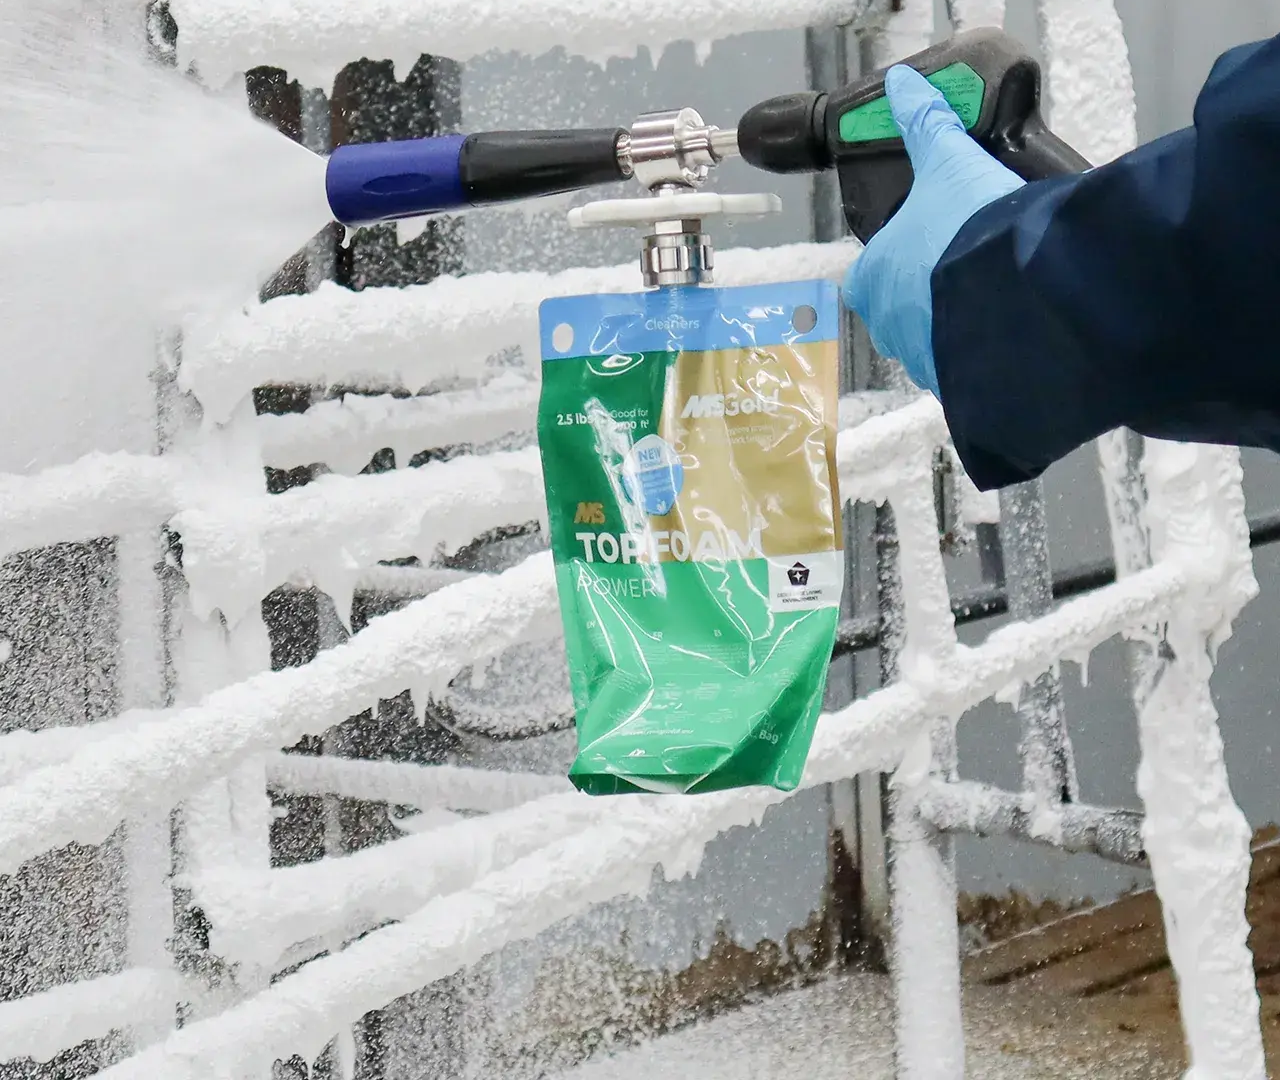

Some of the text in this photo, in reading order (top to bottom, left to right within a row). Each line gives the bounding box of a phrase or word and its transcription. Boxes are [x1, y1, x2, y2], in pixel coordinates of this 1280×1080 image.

[644, 318, 700, 331] Cleaners
[557, 414, 573, 426] 2.5
[611, 409, 649, 419] Good for
[574, 502, 606, 524] MS
[576, 529, 763, 564] TOP FOAM
[577, 577, 656, 598] POWER
[759, 729, 779, 745] Bag
